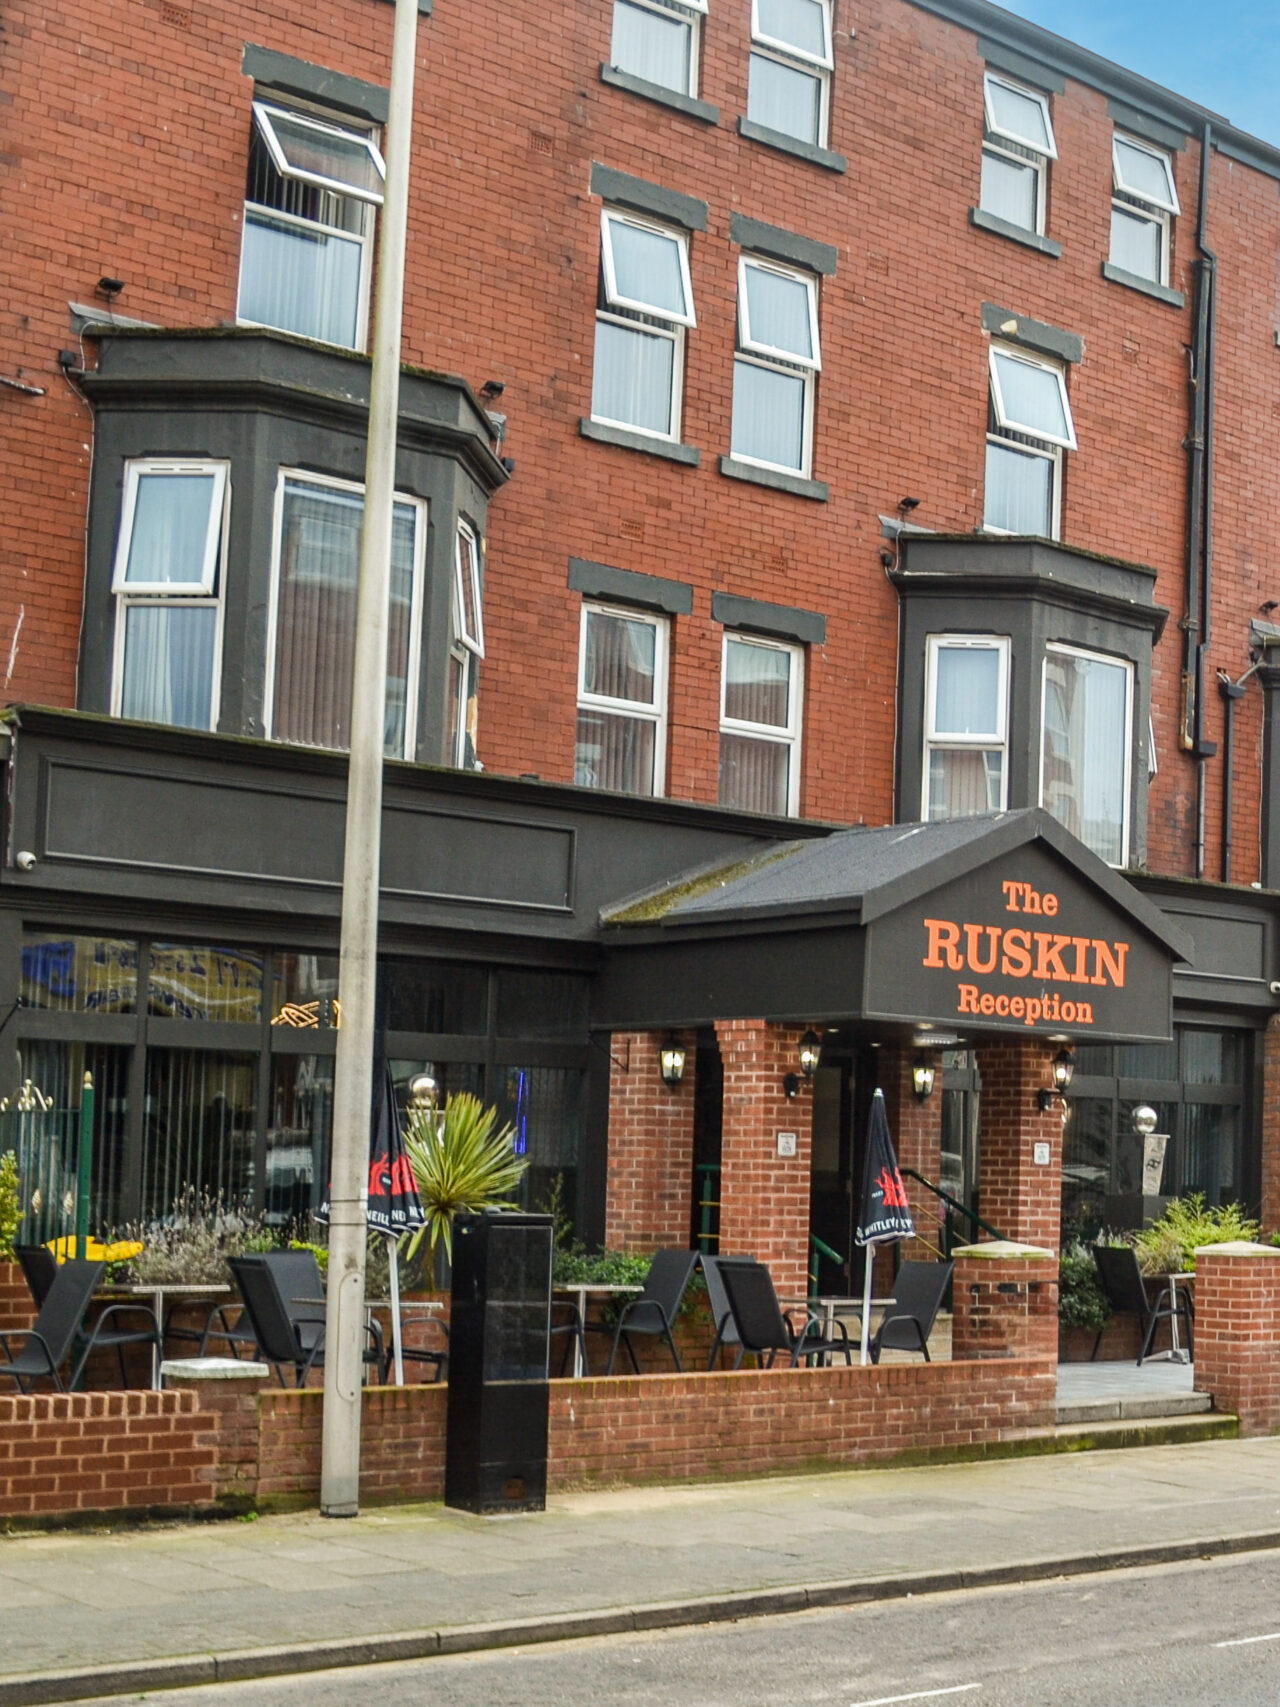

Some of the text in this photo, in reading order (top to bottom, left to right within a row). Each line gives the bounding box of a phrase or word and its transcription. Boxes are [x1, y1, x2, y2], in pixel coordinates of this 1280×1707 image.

[1002, 880, 1059, 916] The
[922, 918, 1130, 988] RUSKIN
[957, 983, 1094, 1026] Reception
